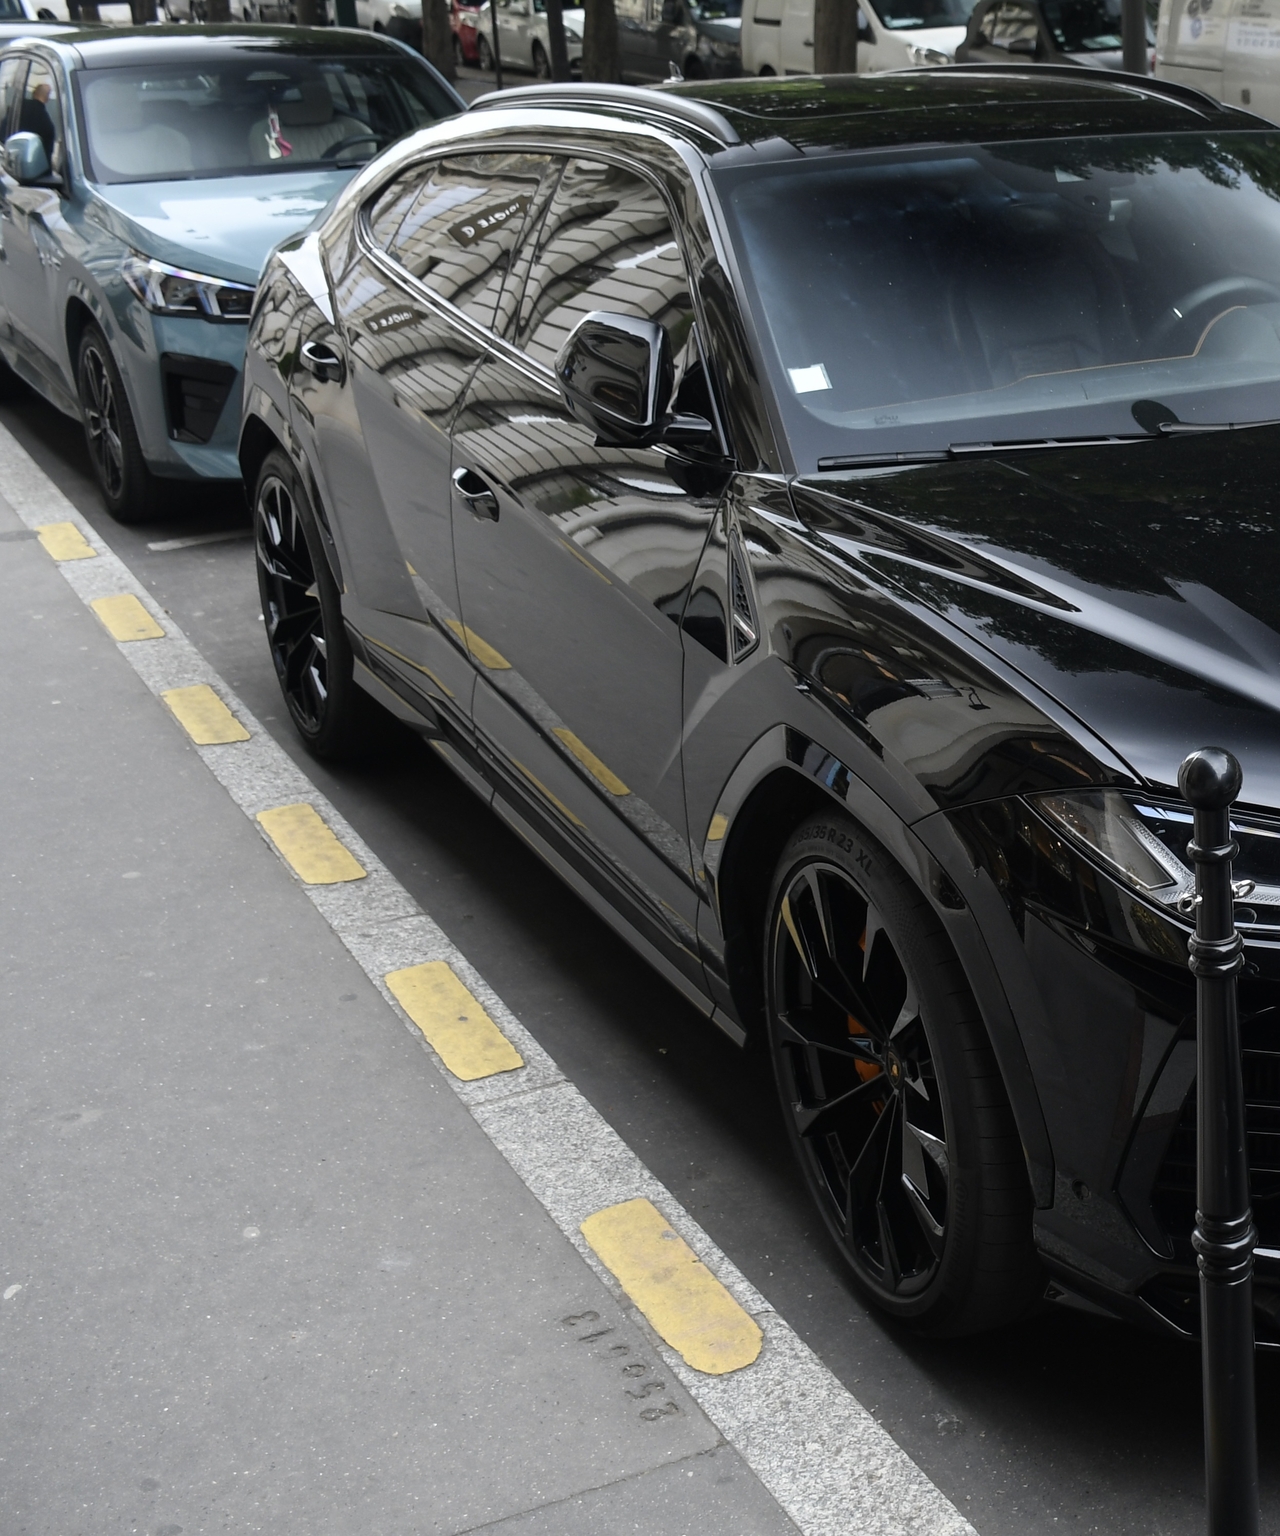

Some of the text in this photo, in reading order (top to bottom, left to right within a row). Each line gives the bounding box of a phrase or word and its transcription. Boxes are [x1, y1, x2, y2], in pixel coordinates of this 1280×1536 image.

[827, 827, 837, 843] R
[837, 833, 854, 854] 23
[856, 849, 873, 877] XL
